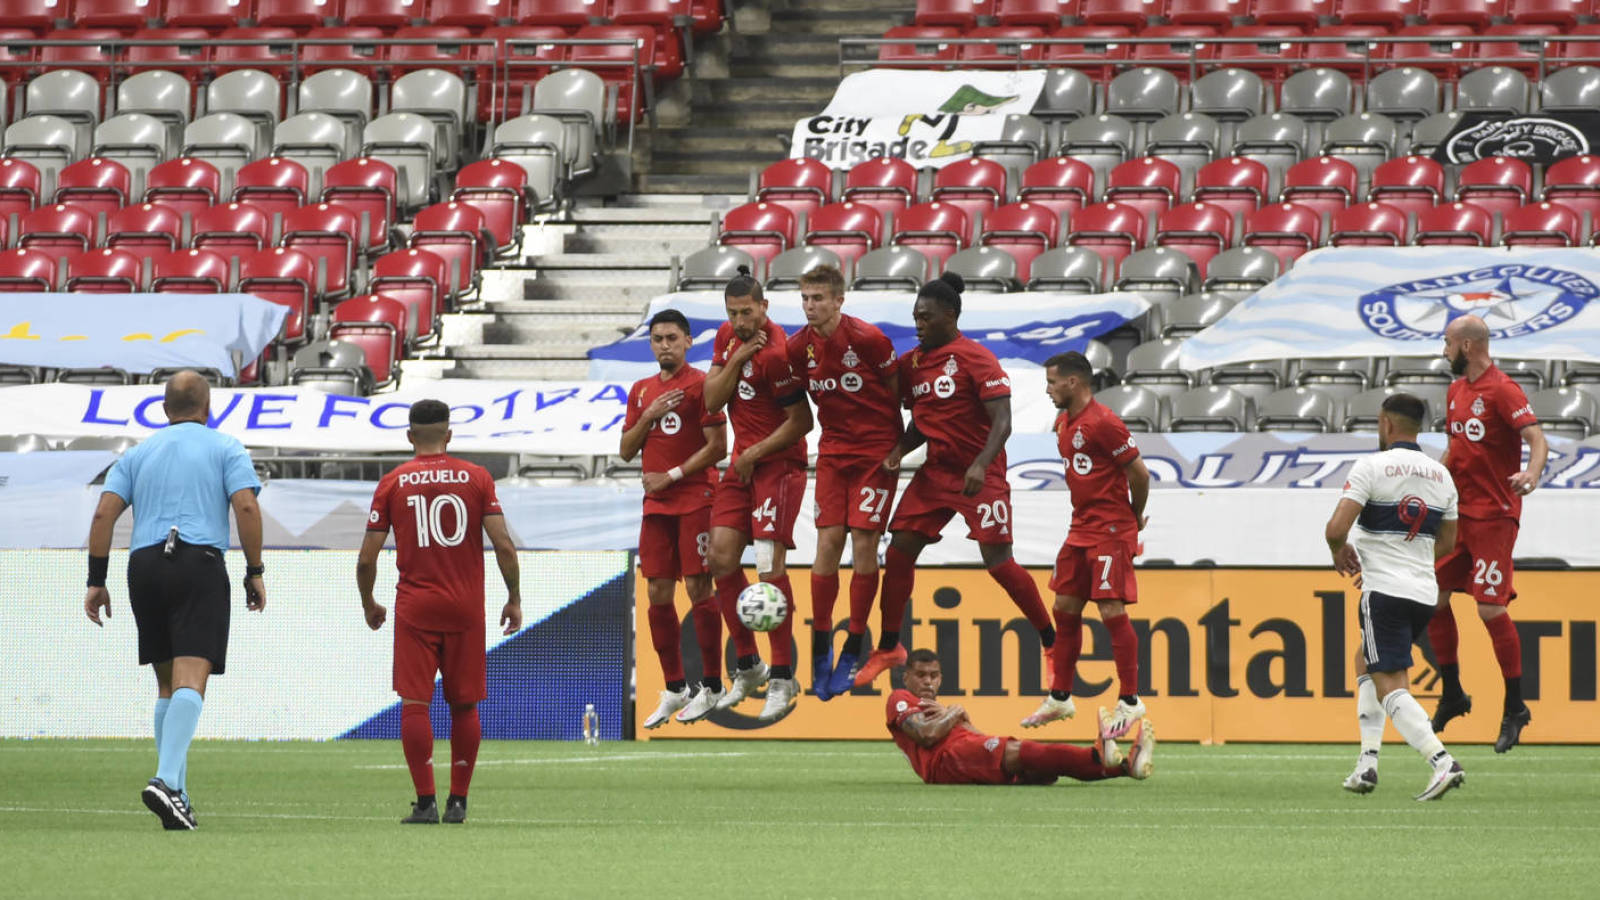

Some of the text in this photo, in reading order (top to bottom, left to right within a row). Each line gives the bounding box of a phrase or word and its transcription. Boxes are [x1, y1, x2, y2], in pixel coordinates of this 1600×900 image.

[807, 115, 871, 136] City
[803, 137, 928, 160] Brigade
[81, 389, 298, 430] LOVE
[398, 469, 470, 487] POZUELO
[1384, 465, 1443, 484] CAVALLINI
[752, 497, 777, 522] 44
[858, 486, 889, 513] 27
[406, 493, 468, 548] 10
[976, 499, 1009, 529] 20
[1397, 493, 1428, 542] 9
[696, 532, 710, 557] 8
[1097, 555, 1113, 581] 7
[1473, 558, 1503, 585] 26
